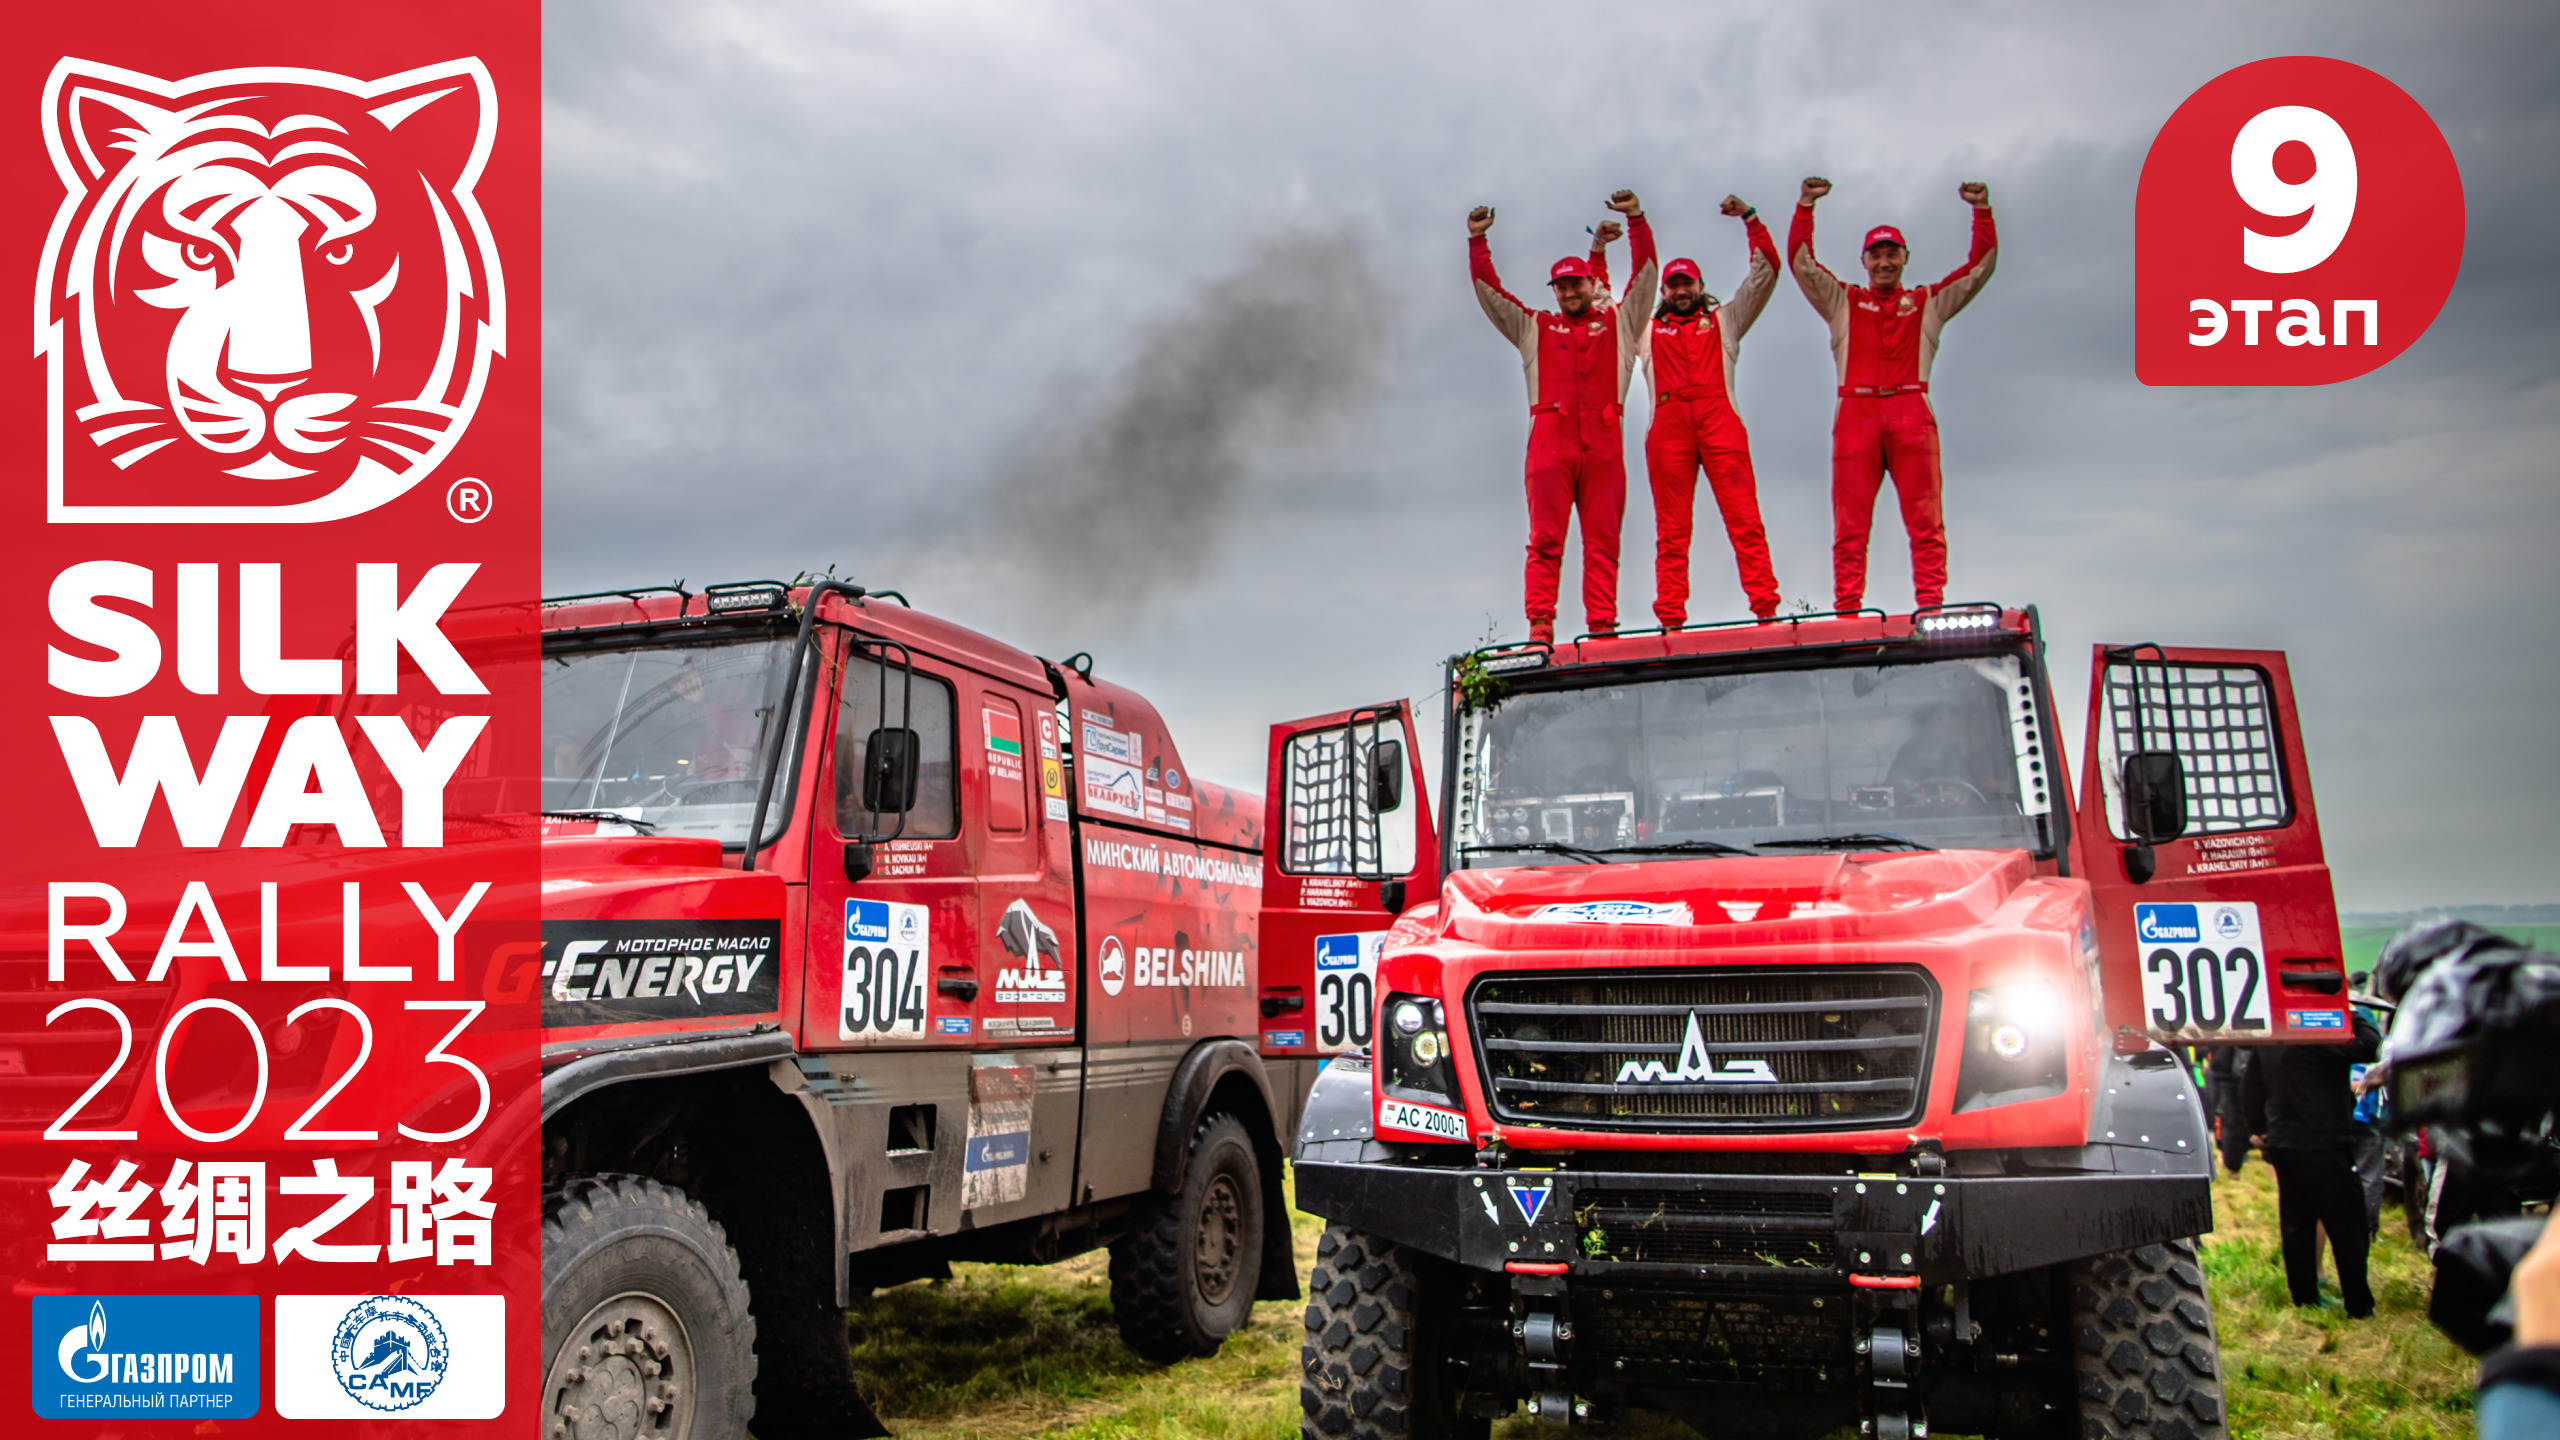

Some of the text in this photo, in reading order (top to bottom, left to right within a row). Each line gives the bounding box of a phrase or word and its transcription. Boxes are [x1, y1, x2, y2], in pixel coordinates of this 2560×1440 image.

[987, 752, 1022, 769] REPUBLIC
[988, 765, 997, 776] OF
[1086, 838, 1160, 874] МИНСКИЙ
[616, 937, 771, 952] МОТОРНОЕ МАСЛО
[2158, 926, 2198, 939] GAZPROM
[1134, 946, 1246, 987] BELSHINA
[845, 946, 924, 1033] 304
[2147, 946, 2266, 1033] 302
[1397, 1106, 1465, 1138] AC 2000-7
